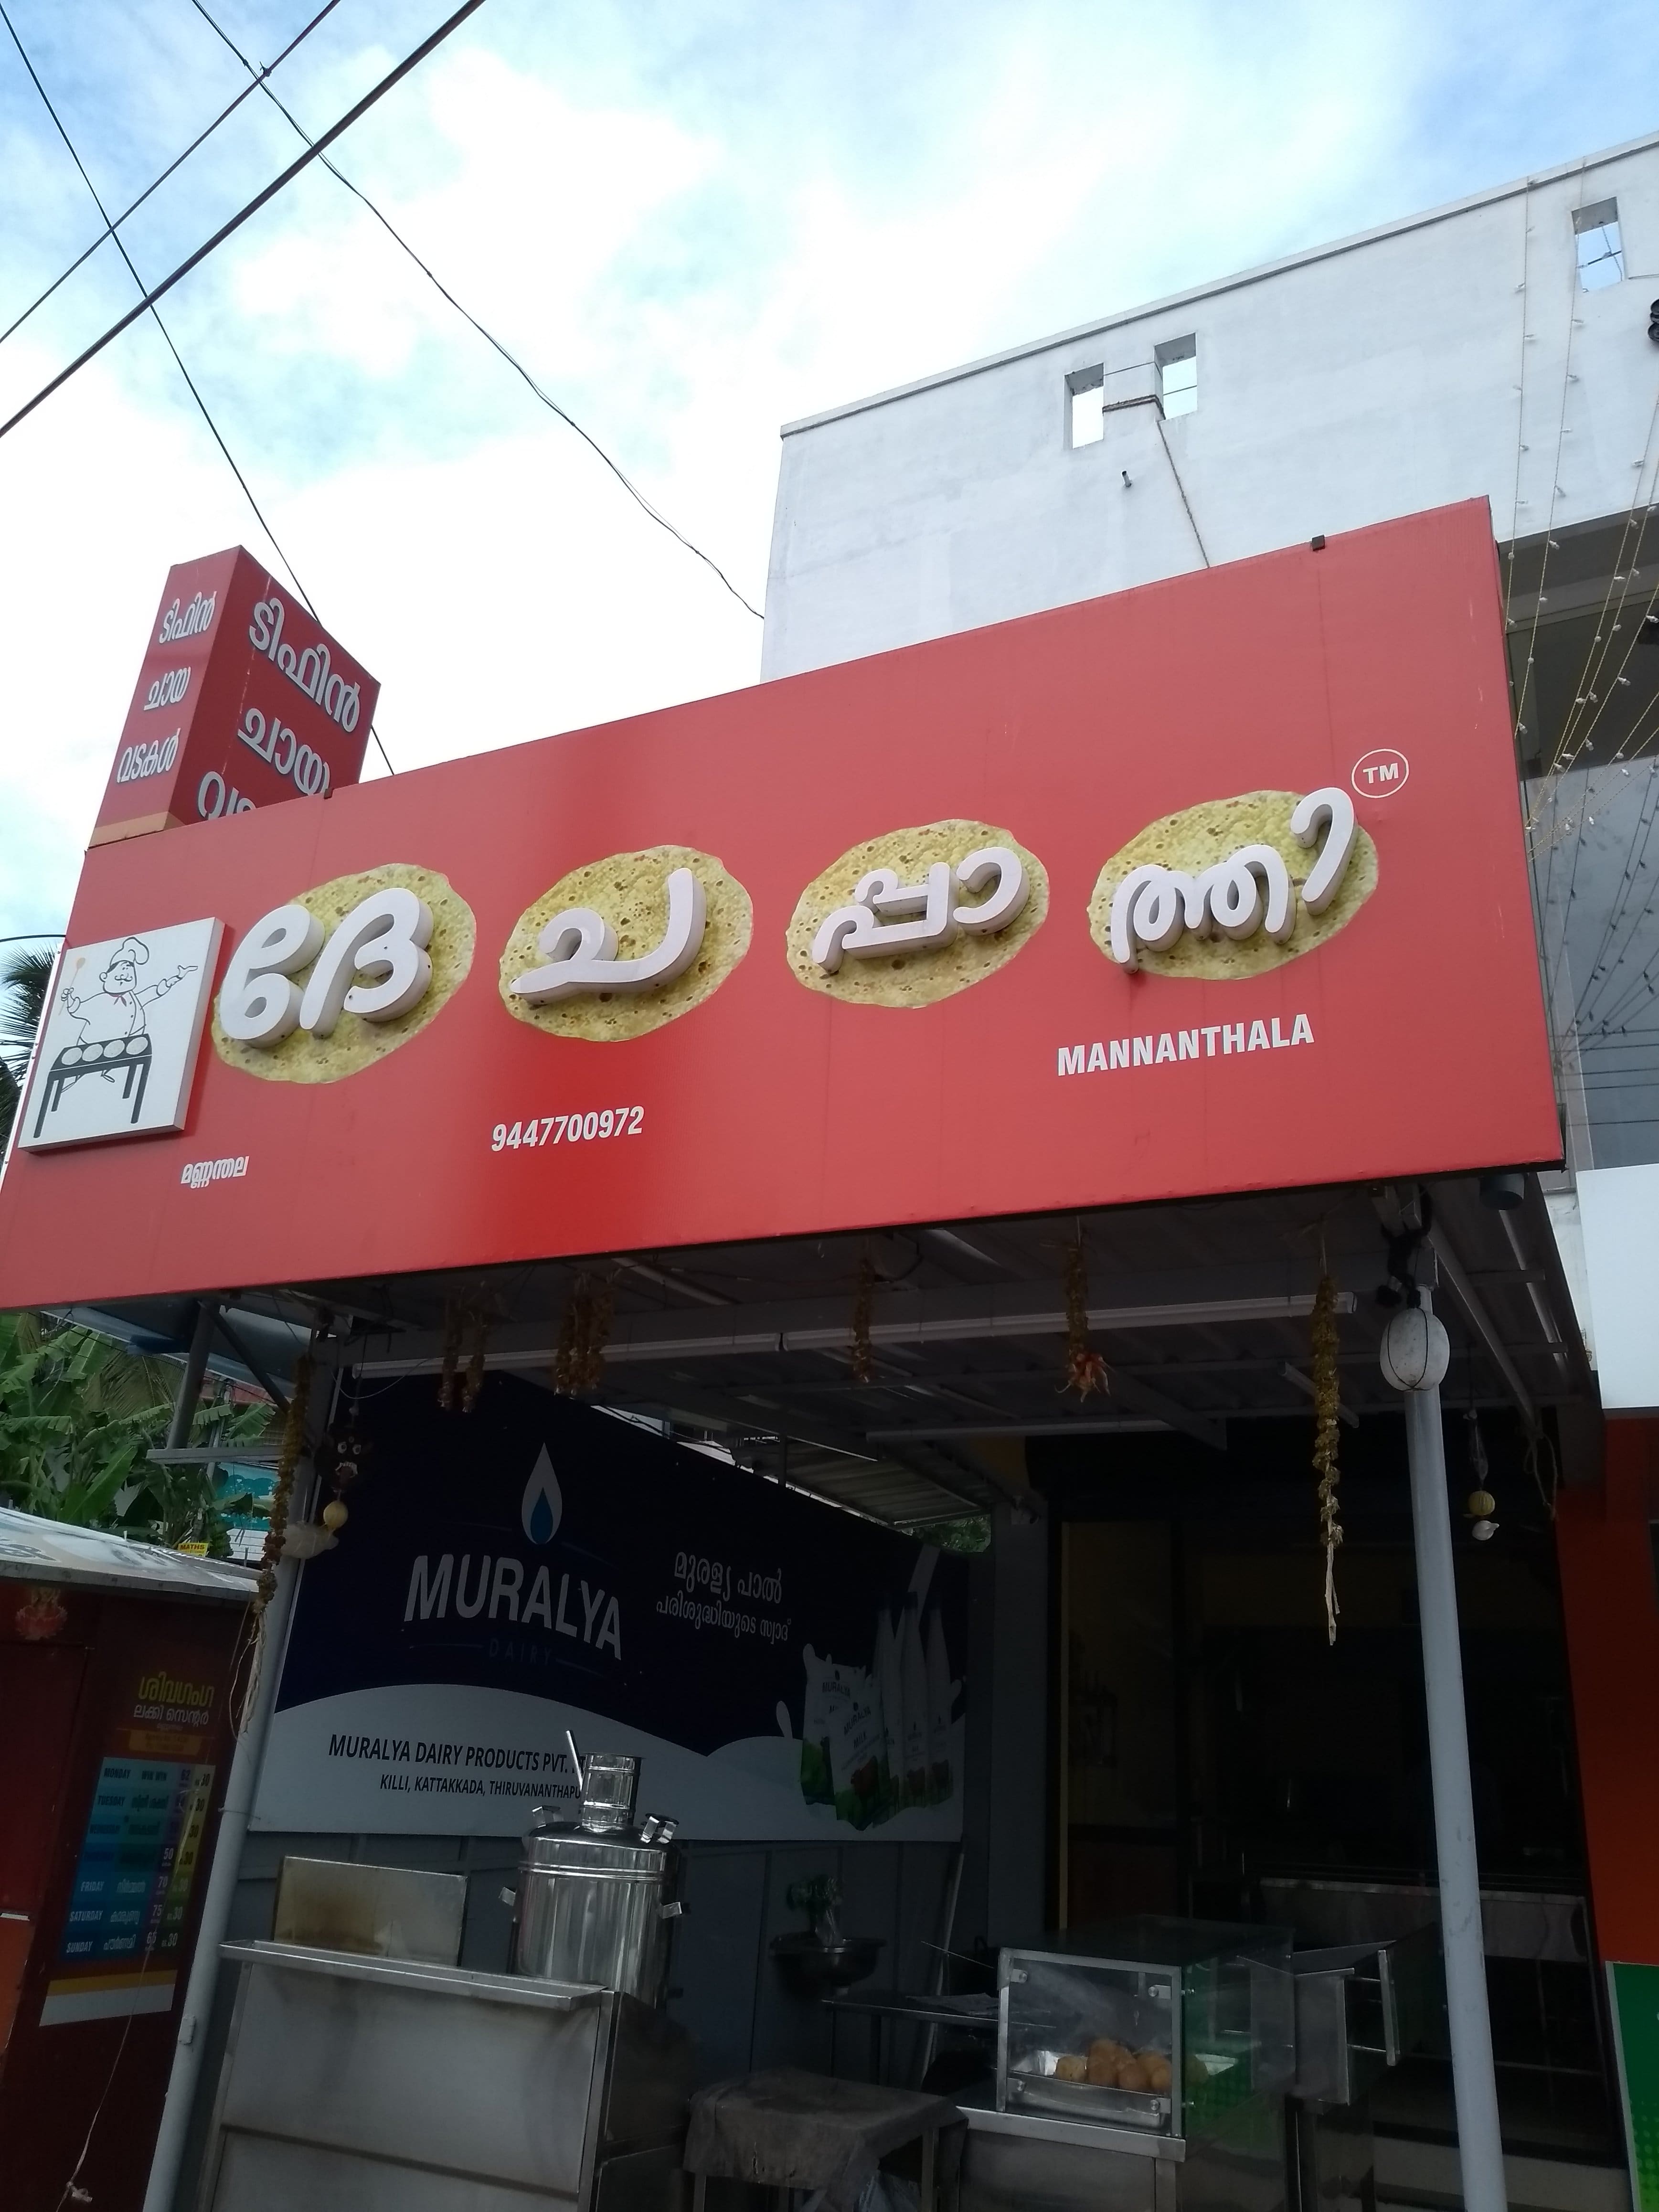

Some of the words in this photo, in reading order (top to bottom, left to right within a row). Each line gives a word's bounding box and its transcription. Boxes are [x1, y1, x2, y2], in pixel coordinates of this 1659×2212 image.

[160, 591, 217, 644] ടിഫിൻ
[249, 597, 361, 733] ടിഫിൻ
[144, 667, 191, 711] ചായ
[117, 728, 181, 783] വടകൾ
[237, 708, 331, 797] ചായ
[1362, 763, 1399, 784] TM
[1057, 1013, 1315, 1076] MANNANTHALA
[491, 1106, 645, 1151] 9447700972
[181, 1156, 249, 1189] മണ്ണന്തല
[738, 1567, 782, 1604] പാൽ
[404, 1554, 622, 1661] MURALYA
[489, 1637, 553, 1667] DAIRY
[329, 1733, 411, 1762] MURALYA
[415, 1741, 463, 1765] DAIRY
[466, 1746, 540, 1771] PRODUCTS
[542, 1753, 568, 1773] PVT.
[104, 1768, 131, 1779] MONDAY
[380, 1774, 410, 1792] KILLI,
[414, 1776, 486, 1797] KATTAKKADA,
[97, 1795, 126, 1807] TUESDAY
[81, 1881, 105, 1892] FRIDAY
[70, 1911, 103, 1922] SATURDAY
[66, 1941, 93, 1953] SUNDAY
